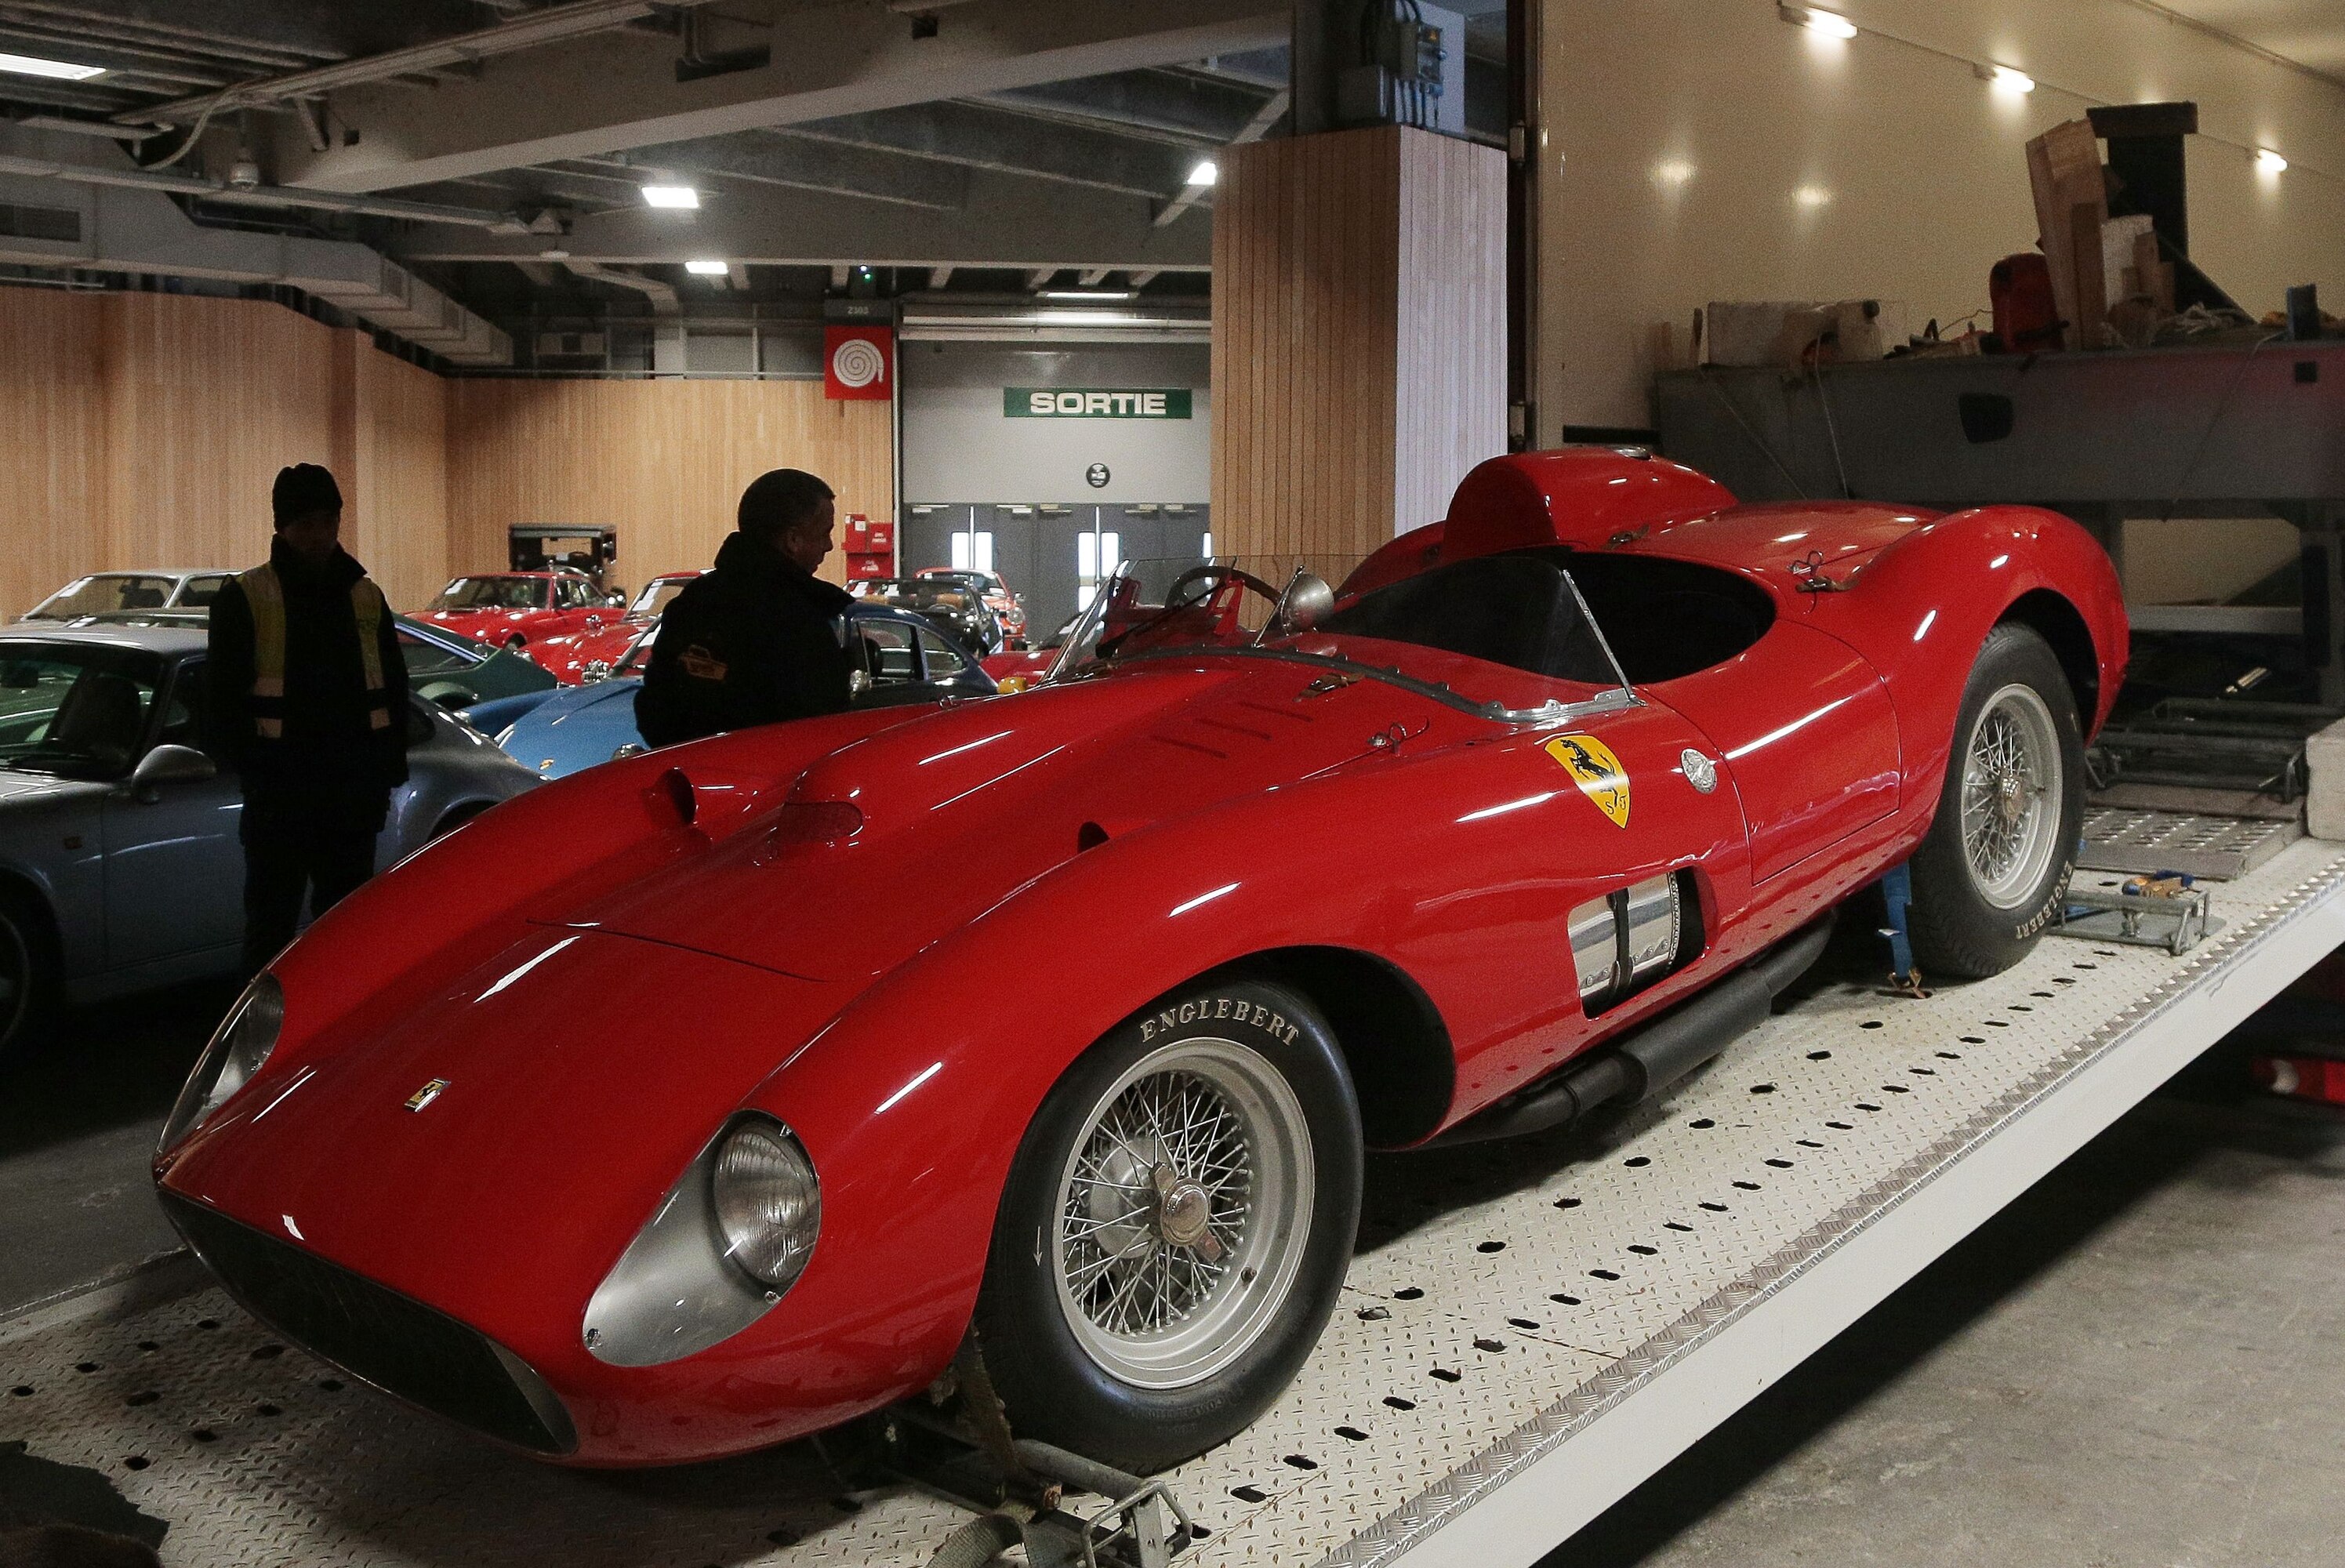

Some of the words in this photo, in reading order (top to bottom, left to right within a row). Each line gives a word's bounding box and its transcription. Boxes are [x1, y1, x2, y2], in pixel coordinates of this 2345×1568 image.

[1030, 392, 1167, 414] SORTIE
[2016, 861, 2074, 939] ENGLEBERT
[1140, 998, 1299, 1047] ENGLEBERT
